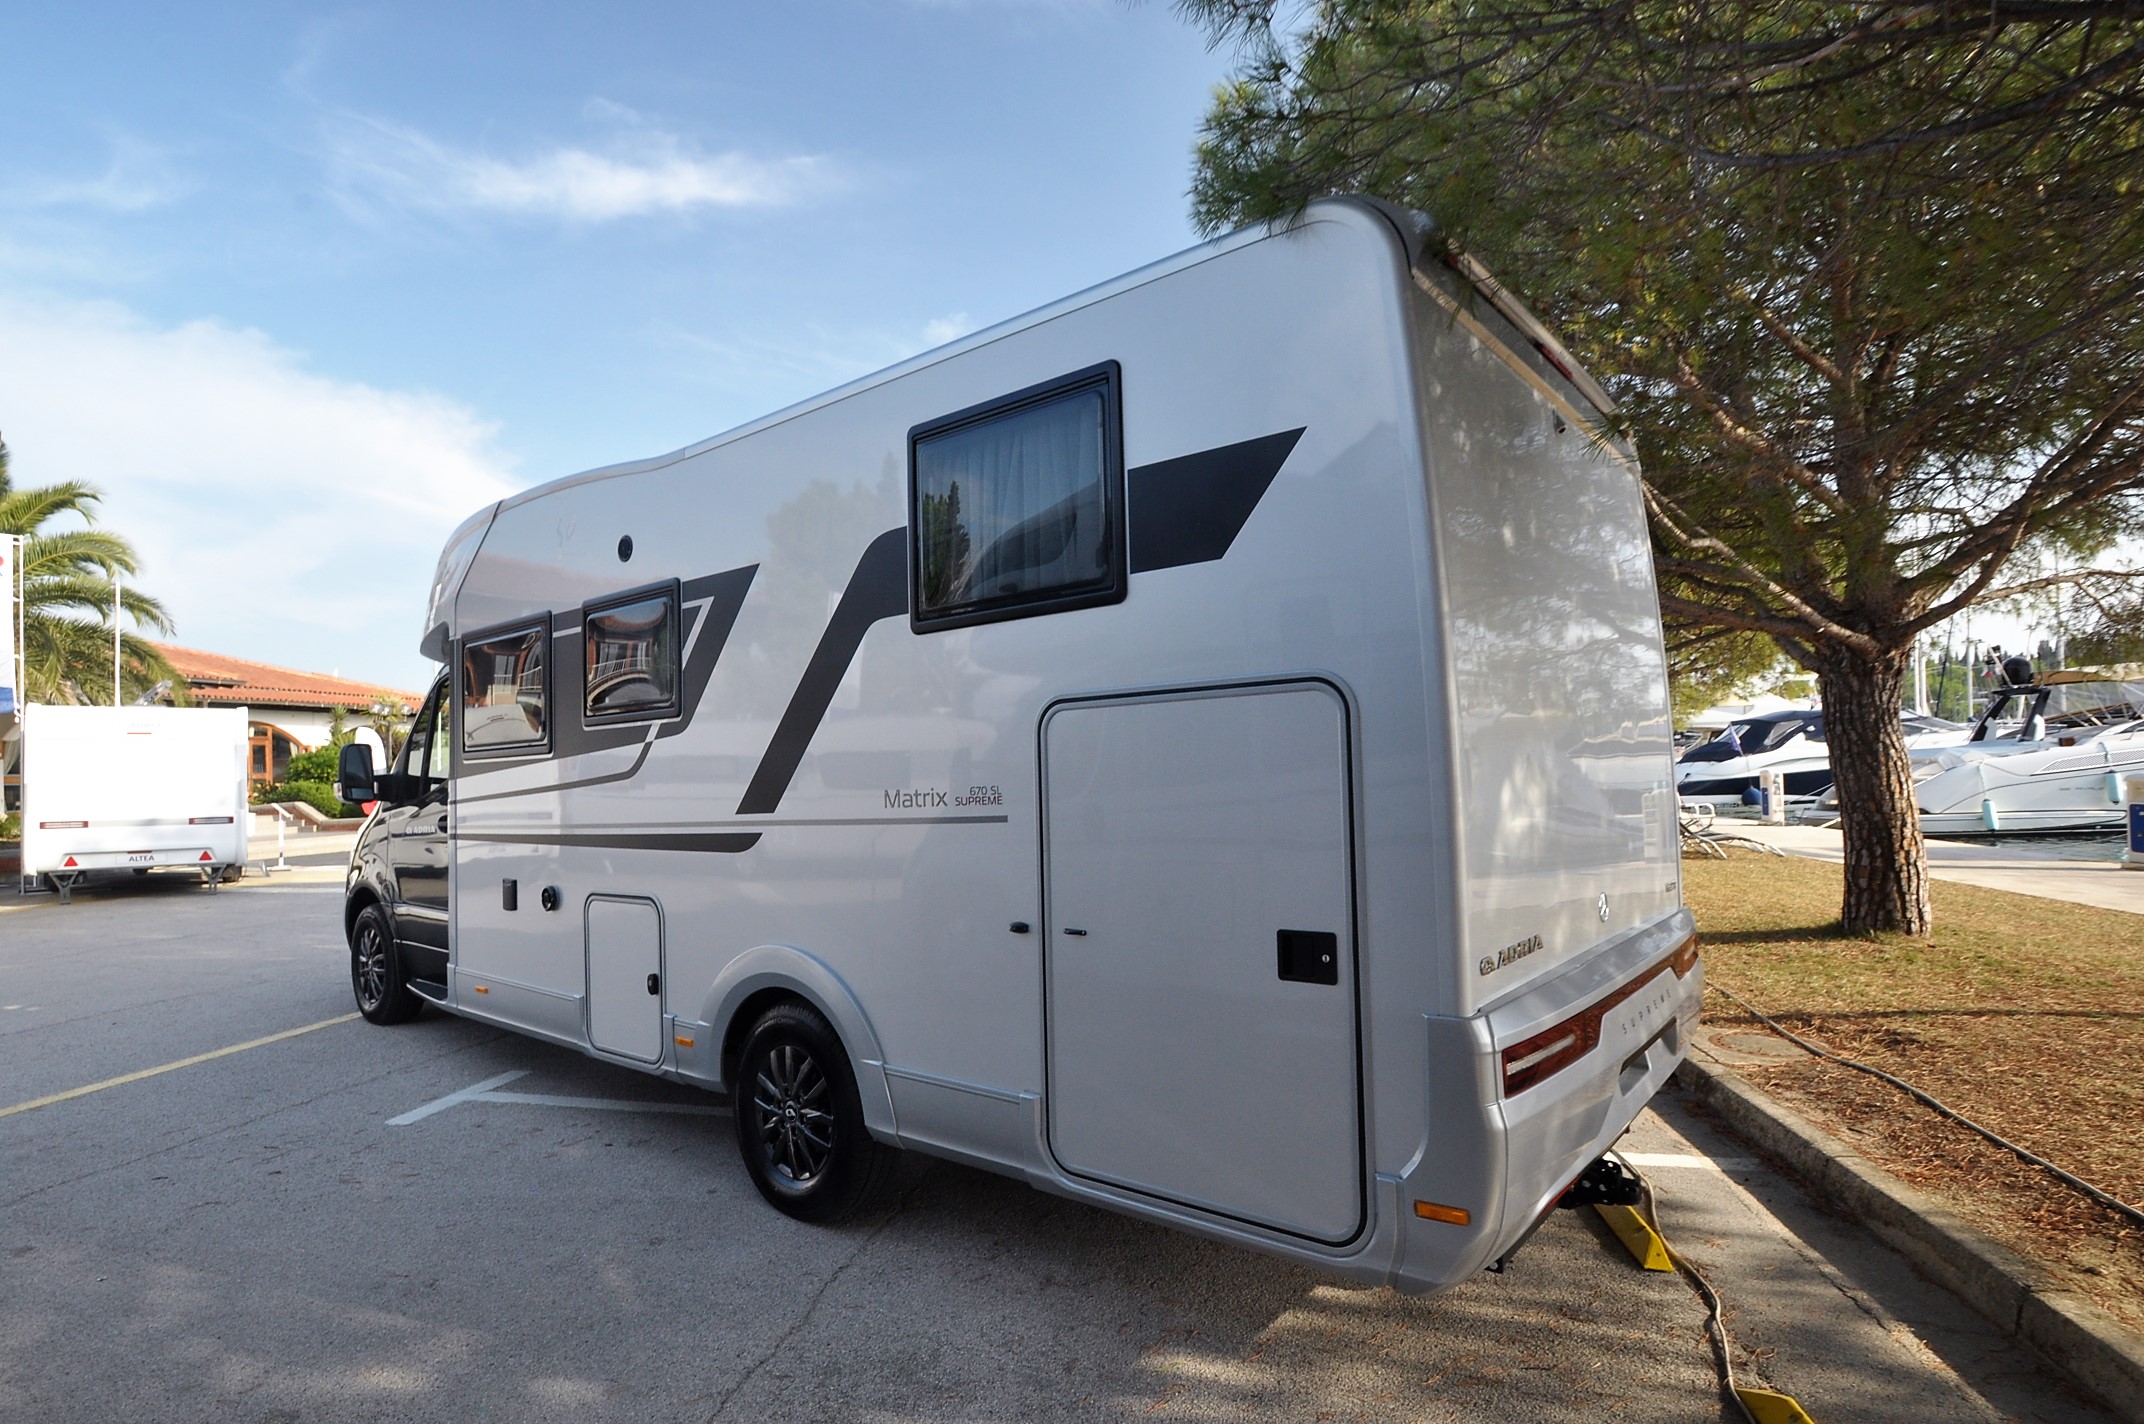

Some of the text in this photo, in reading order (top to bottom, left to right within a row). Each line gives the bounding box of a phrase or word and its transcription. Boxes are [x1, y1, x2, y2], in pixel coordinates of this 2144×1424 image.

[969, 785, 1002, 796] 670 SL
[884, 788, 948, 809] Matrix
[955, 795, 1003, 806] SUPREME
[413, 825, 435, 834] ADRIA
[128, 854, 155, 863] ALTEA
